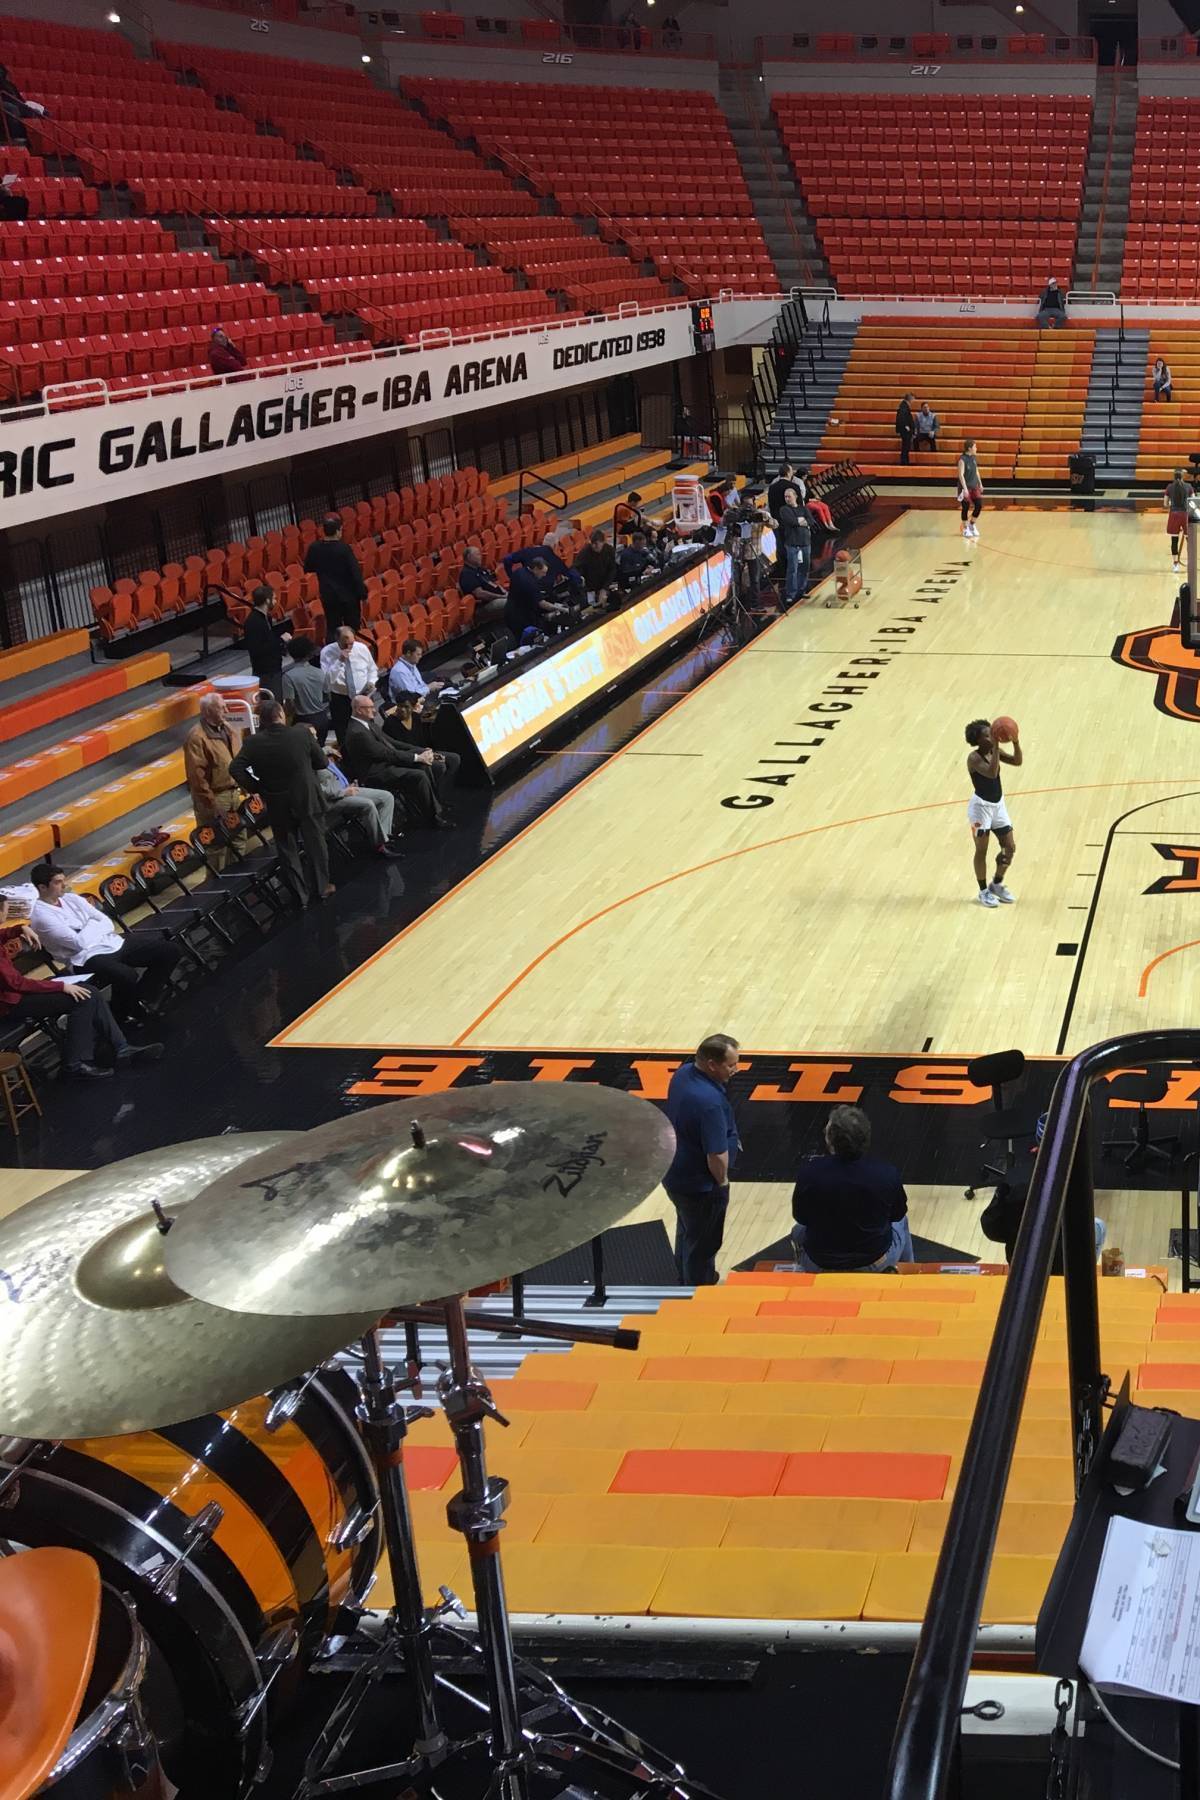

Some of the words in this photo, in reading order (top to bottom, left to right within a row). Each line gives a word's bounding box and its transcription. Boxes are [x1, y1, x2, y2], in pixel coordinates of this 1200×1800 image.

[250, 18, 270, 33] 215
[542, 52, 574, 64] 216
[910, 64, 943, 76] 217
[99, 369, 432, 475] GALLAGHER-IBA
[444, 351, 528, 398] ARENA
[553, 333, 633, 371] DEDICATED
[636, 328, 666, 353] 1938
[908, 560, 973, 604] ARENA
[542, 1130, 609, 1198] Zildjian
